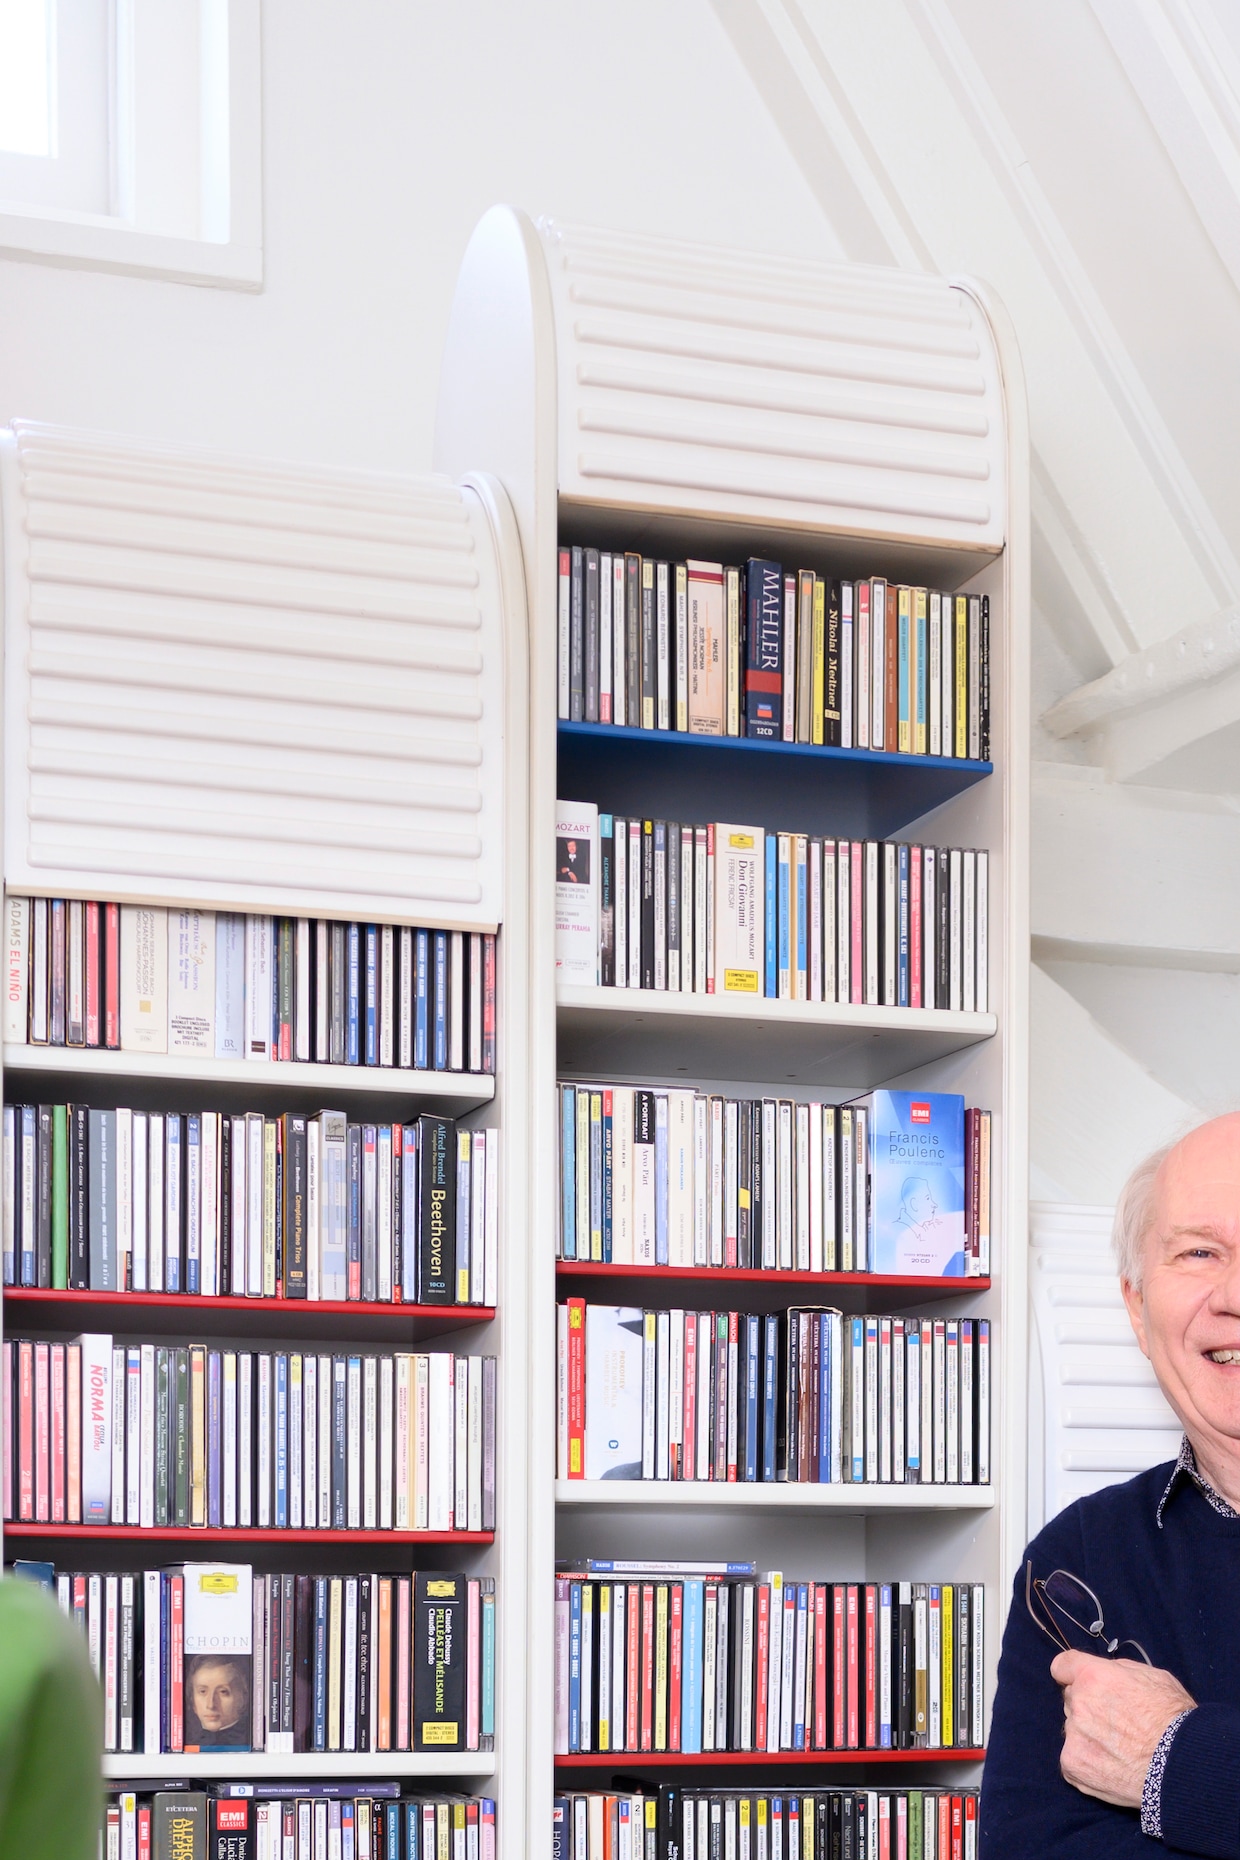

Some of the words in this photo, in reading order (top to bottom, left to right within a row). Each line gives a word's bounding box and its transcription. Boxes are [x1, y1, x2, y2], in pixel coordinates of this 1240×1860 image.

[761, 569, 779, 669] MAHLER
[828, 609, 838, 652] Nikolai
[828, 657, 837, 707] Medtner
[738, 860, 748, 881] Don
[737, 884, 748, 927] Giovanni
[10, 901, 21, 946] ADAMS
[10, 950, 20, 964] EL
[9, 969, 22, 1001] NIÑO
[437, 1124, 445, 1150] Alfred
[890, 1131, 939, 1144] Francis
[890, 1145, 945, 1159] Poulenc
[437, 1153, 445, 1184] Brendel
[294, 1195, 302, 1226] Complete
[431, 1190, 446, 1276] Beethoven
[90, 1364, 104, 1422] NORMA
[186, 1637, 248, 1646] CHOPIN
[436, 1609, 445, 1646] PELLÉAS
[436, 1648, 444, 1658] ET
[444, 1635, 452, 1665] Debussy
[436, 1661, 445, 1713] MÉLISANDE
[220, 1812, 244, 1820] EMI
